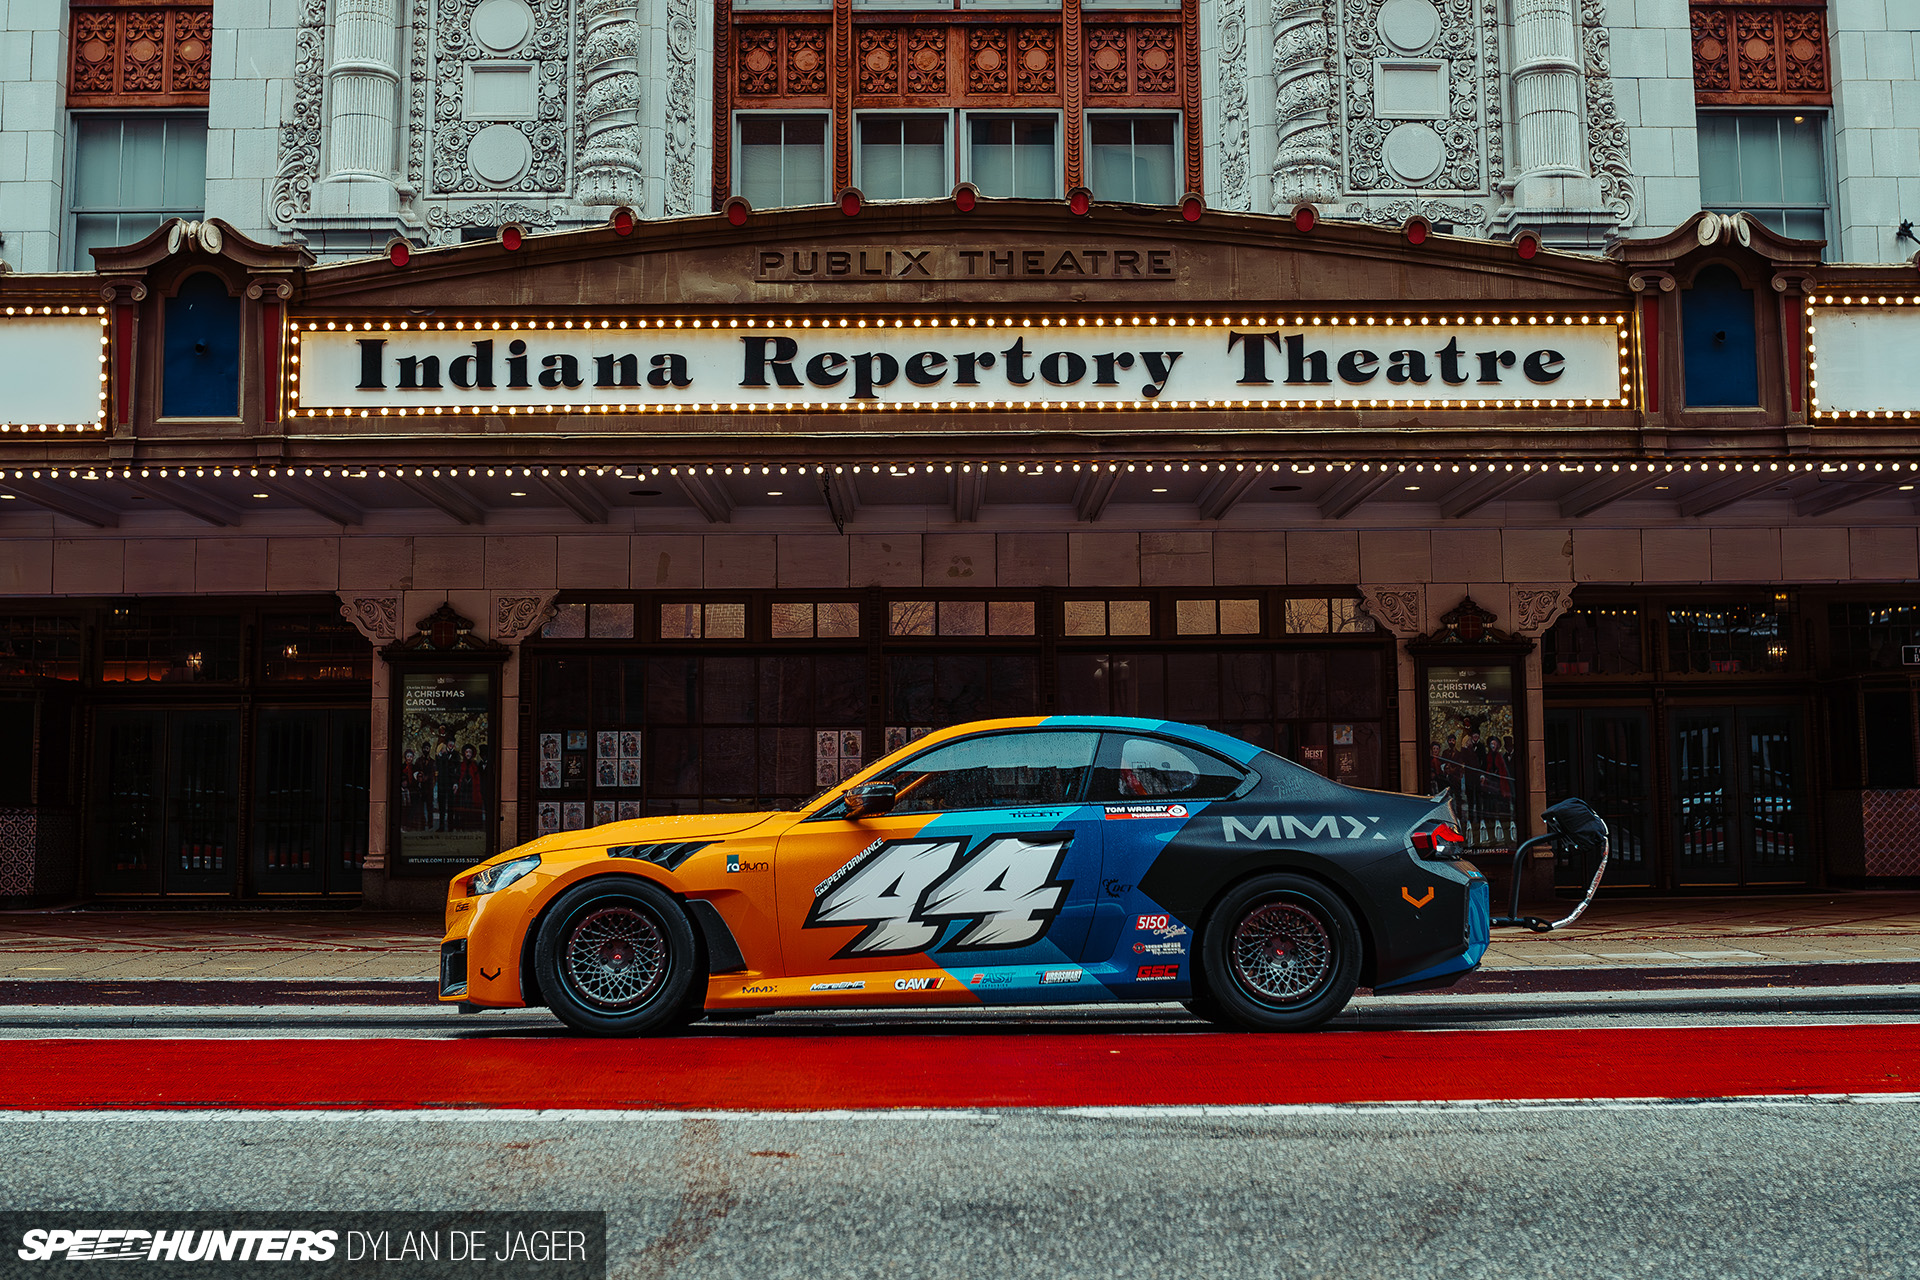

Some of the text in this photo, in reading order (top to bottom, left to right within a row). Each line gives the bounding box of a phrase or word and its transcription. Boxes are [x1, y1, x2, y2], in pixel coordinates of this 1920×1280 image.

[758, 249, 1172, 277] PUBLIX THEATRE
[356, 330, 1566, 400] Indiana Repertory Theatre
[1429, 683, 1487, 691] A CHRISTMAS
[406, 690, 465, 698] A CHRISTMAS
[1429, 691, 1460, 699] CAROL
[406, 698, 437, 706] CAROL
[1304, 750, 1324, 758] HEIST
[1105, 805, 1168, 814] TOM WRIGLEY
[1221, 815, 1387, 842] MMX
[727, 860, 769, 872] radium
[827, 837, 884, 886] PERFORMANCE
[814, 837, 1064, 953] 44
[1137, 916, 1168, 929] 5150
[1136, 964, 1179, 978] GSC
[894, 978, 928, 990] GAW
